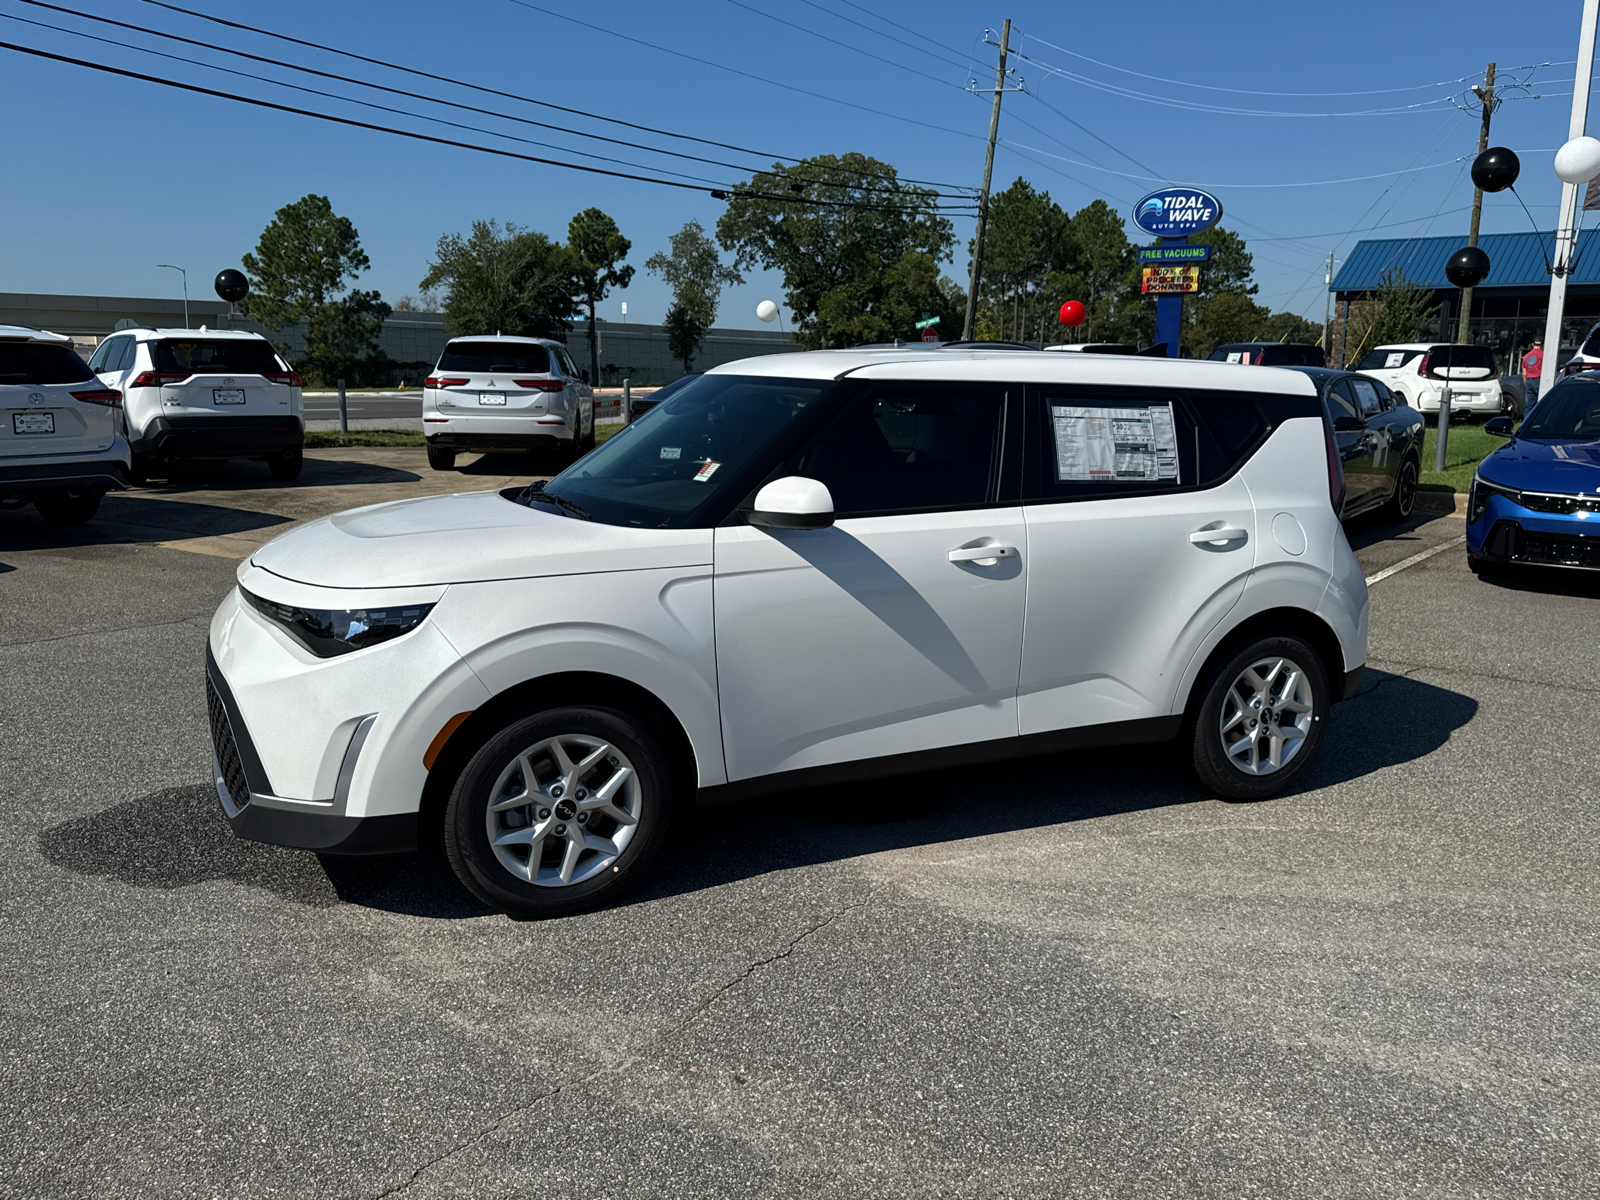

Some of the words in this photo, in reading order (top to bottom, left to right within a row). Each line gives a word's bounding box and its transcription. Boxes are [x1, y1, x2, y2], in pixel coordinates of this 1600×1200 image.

[1164, 196, 1203, 209] TIDAL
[1169, 208, 1212, 222] WAVE
[1140, 249, 1162, 259] FREE
[1164, 248, 1205, 258] VACUUMS
[1146, 276, 1194, 284] PROCEEDS
[1147, 283, 1193, 291] DONATED
